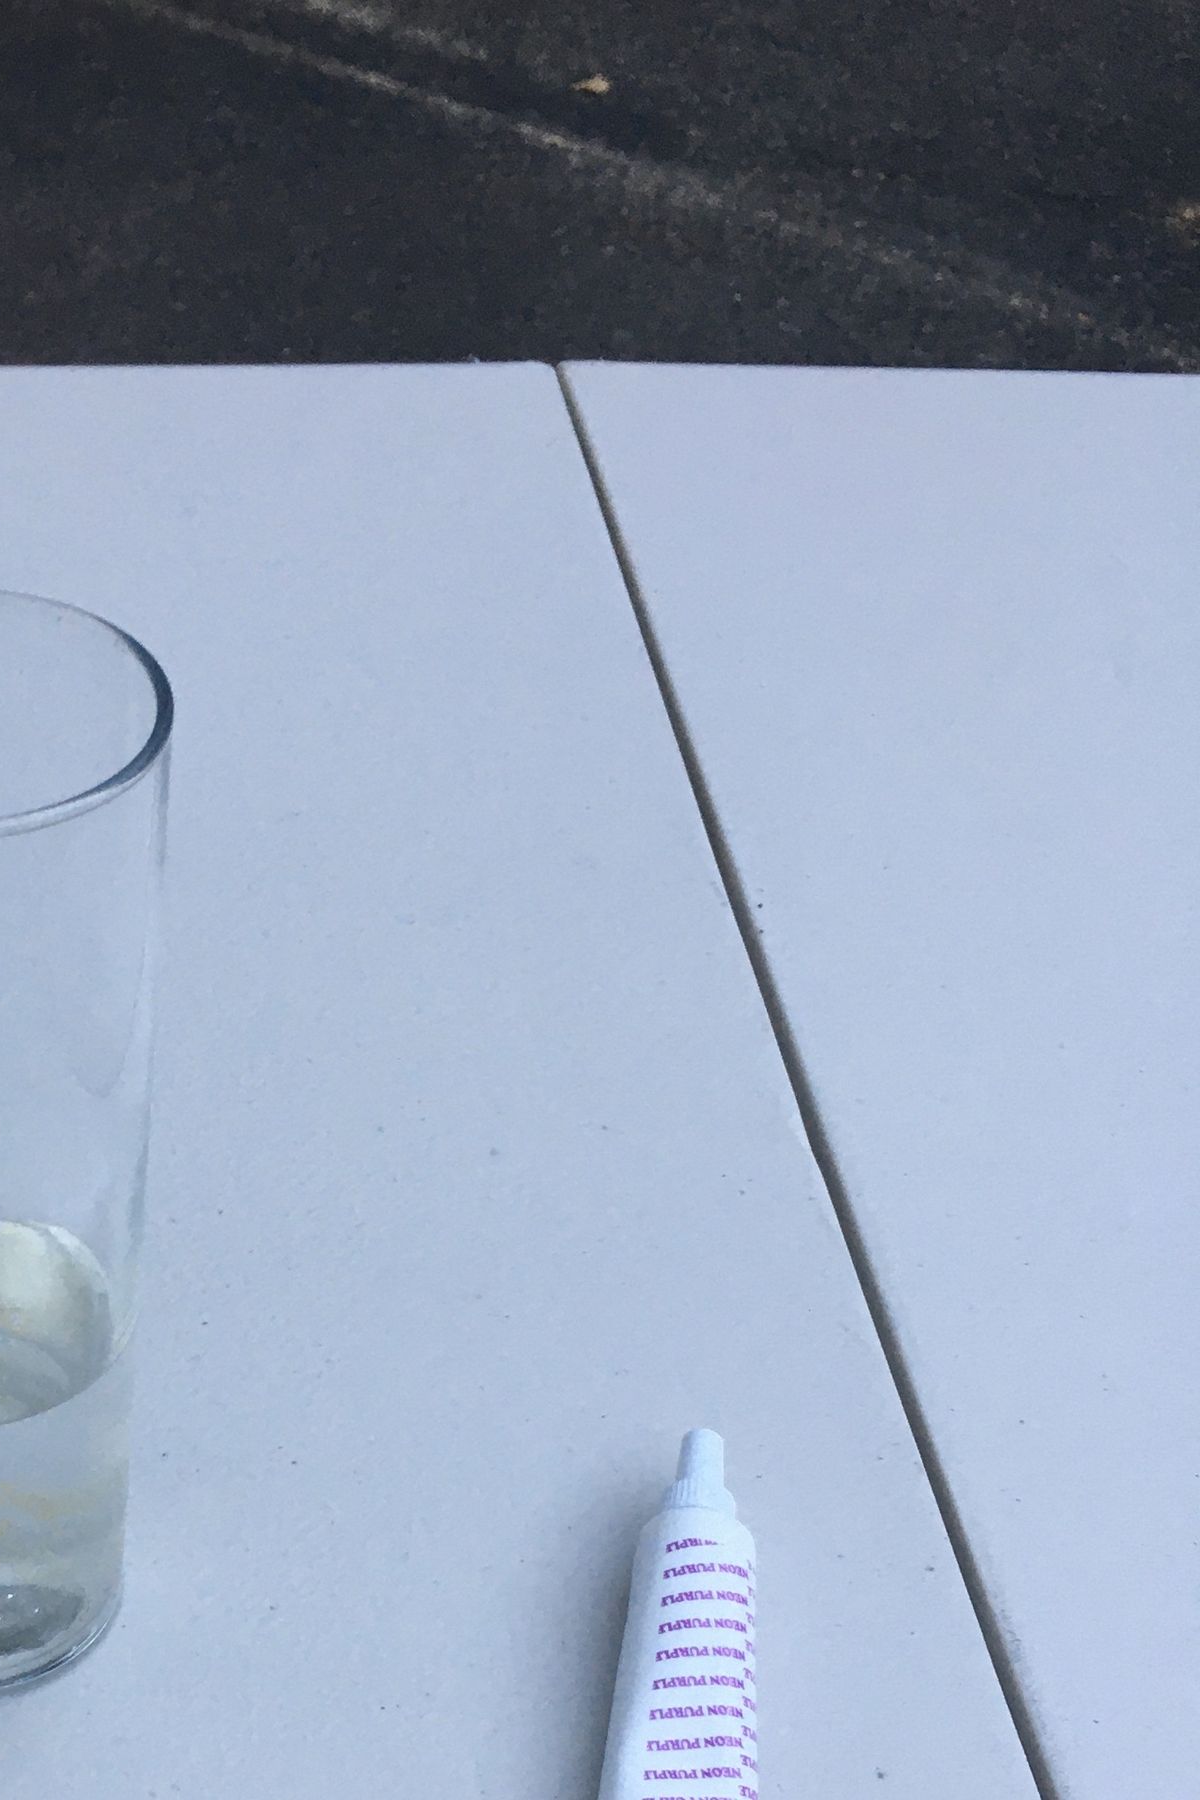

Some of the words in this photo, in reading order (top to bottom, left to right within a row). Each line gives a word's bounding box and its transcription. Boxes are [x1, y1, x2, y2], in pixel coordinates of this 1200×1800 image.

[718, 1563, 749, 1580] NEON
[716, 1590, 749, 1607] NEON
[713, 1618, 748, 1634] NEON
[711, 1646, 746, 1662] NEON
[709, 1675, 745, 1690] NEON
[706, 1705, 744, 1719] NEON
[703, 1735, 744, 1749] NEON
[700, 1767, 742, 1779] NEON
